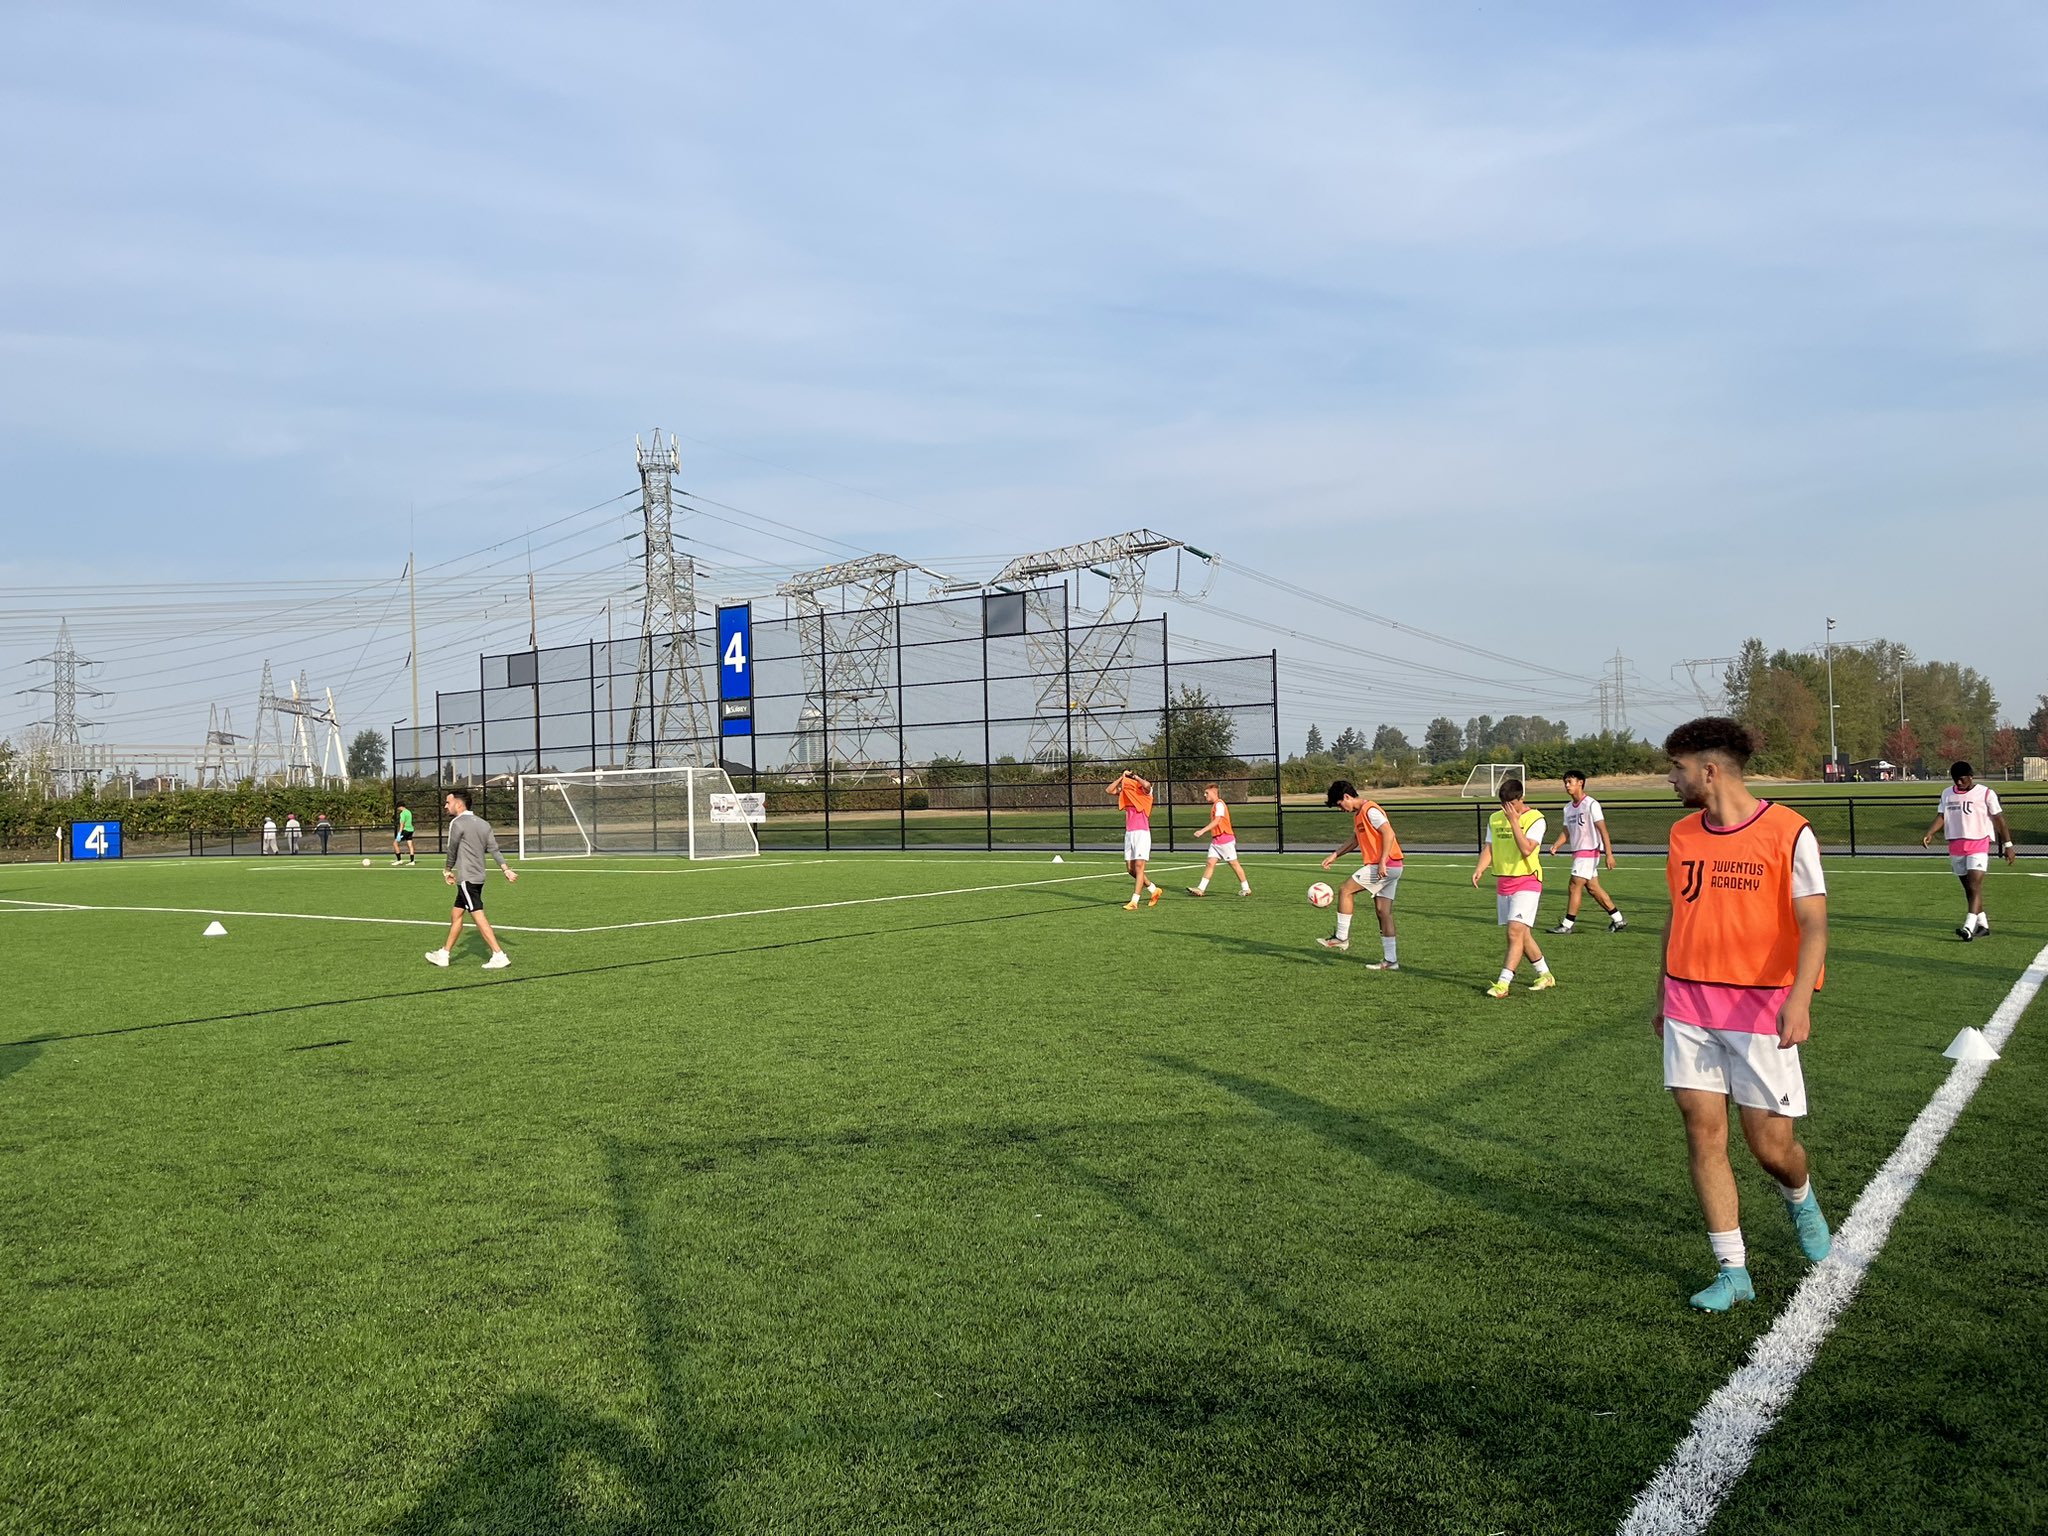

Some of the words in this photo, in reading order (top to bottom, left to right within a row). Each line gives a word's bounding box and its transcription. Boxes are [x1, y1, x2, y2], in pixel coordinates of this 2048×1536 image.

[724, 632, 747, 673] 4
[84, 825, 109, 855] 4
[1712, 860, 1764, 876] JUVENTUS
[1711, 876, 1760, 891] ACADEMY
